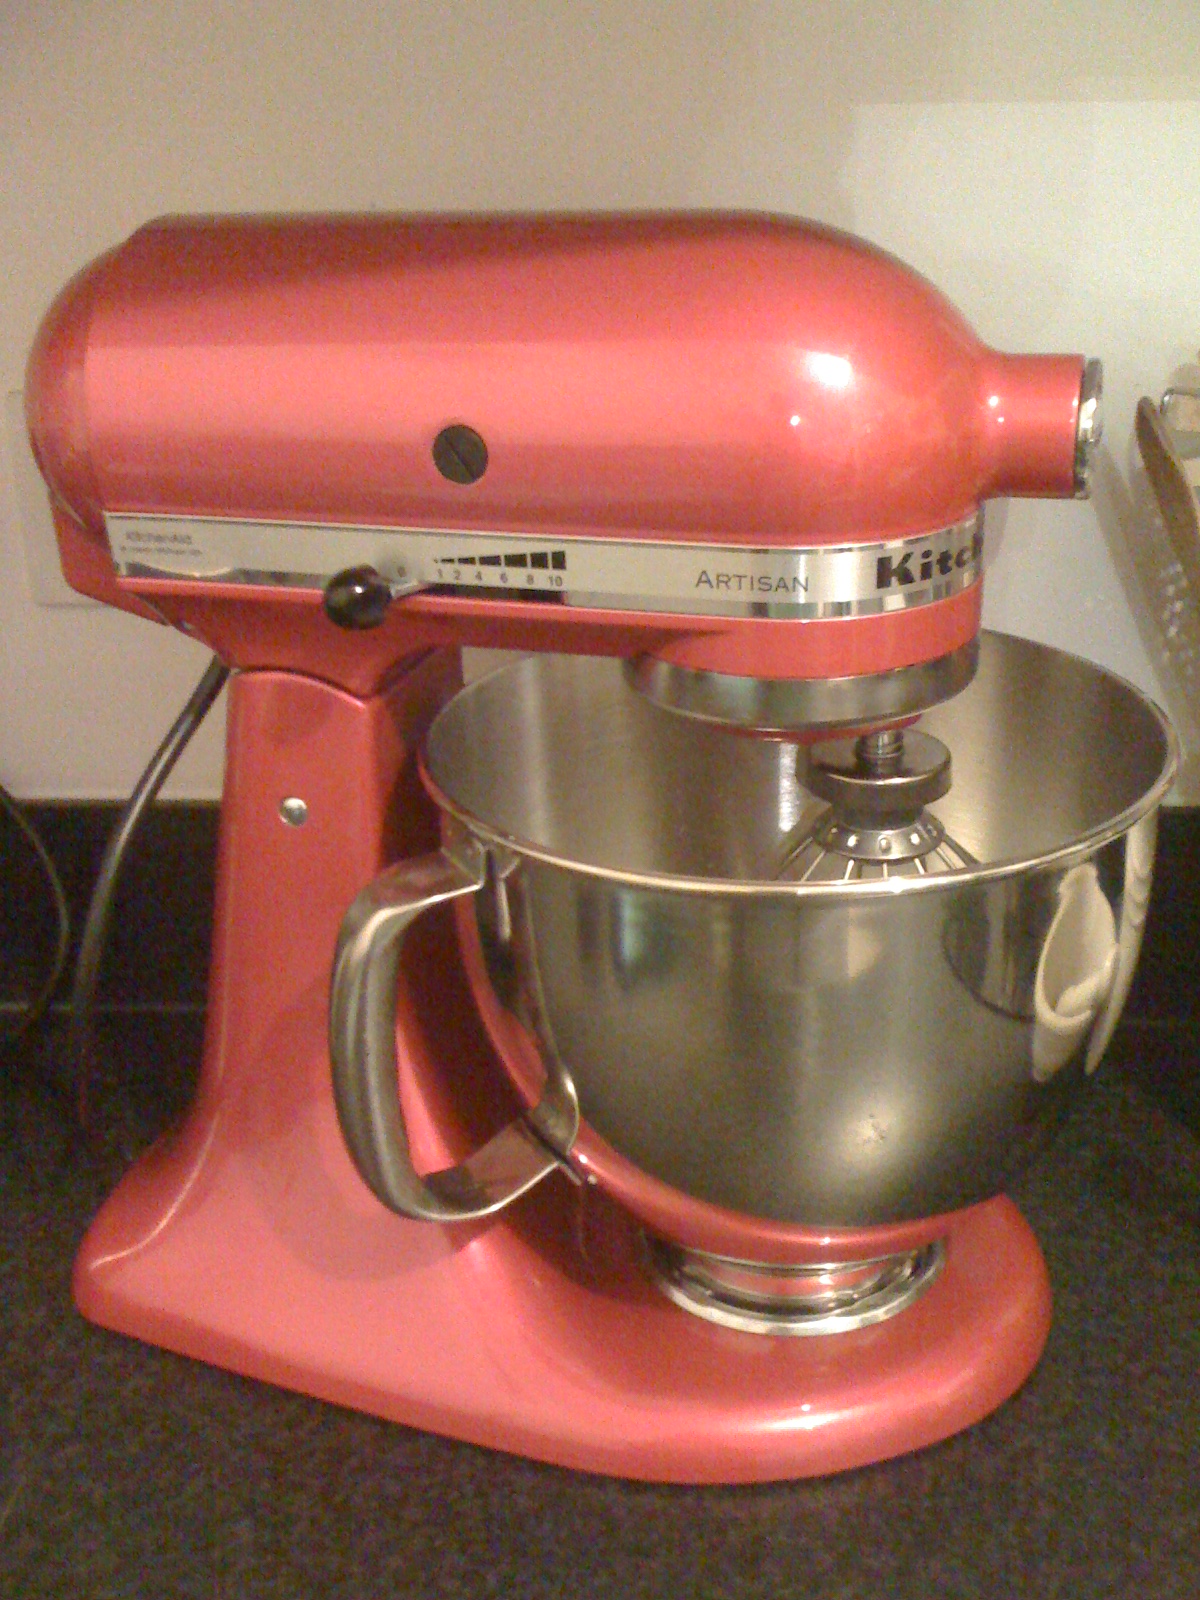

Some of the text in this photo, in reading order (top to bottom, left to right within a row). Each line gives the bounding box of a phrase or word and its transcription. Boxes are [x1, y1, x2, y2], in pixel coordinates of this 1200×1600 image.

[453, 568, 461, 580] 2
[475, 570, 482, 581] 4
[500, 571, 508, 583] 6
[527, 573, 535, 585] 8
[548, 574, 563, 587] 10
[695, 569, 809, 593] ARTISAN
